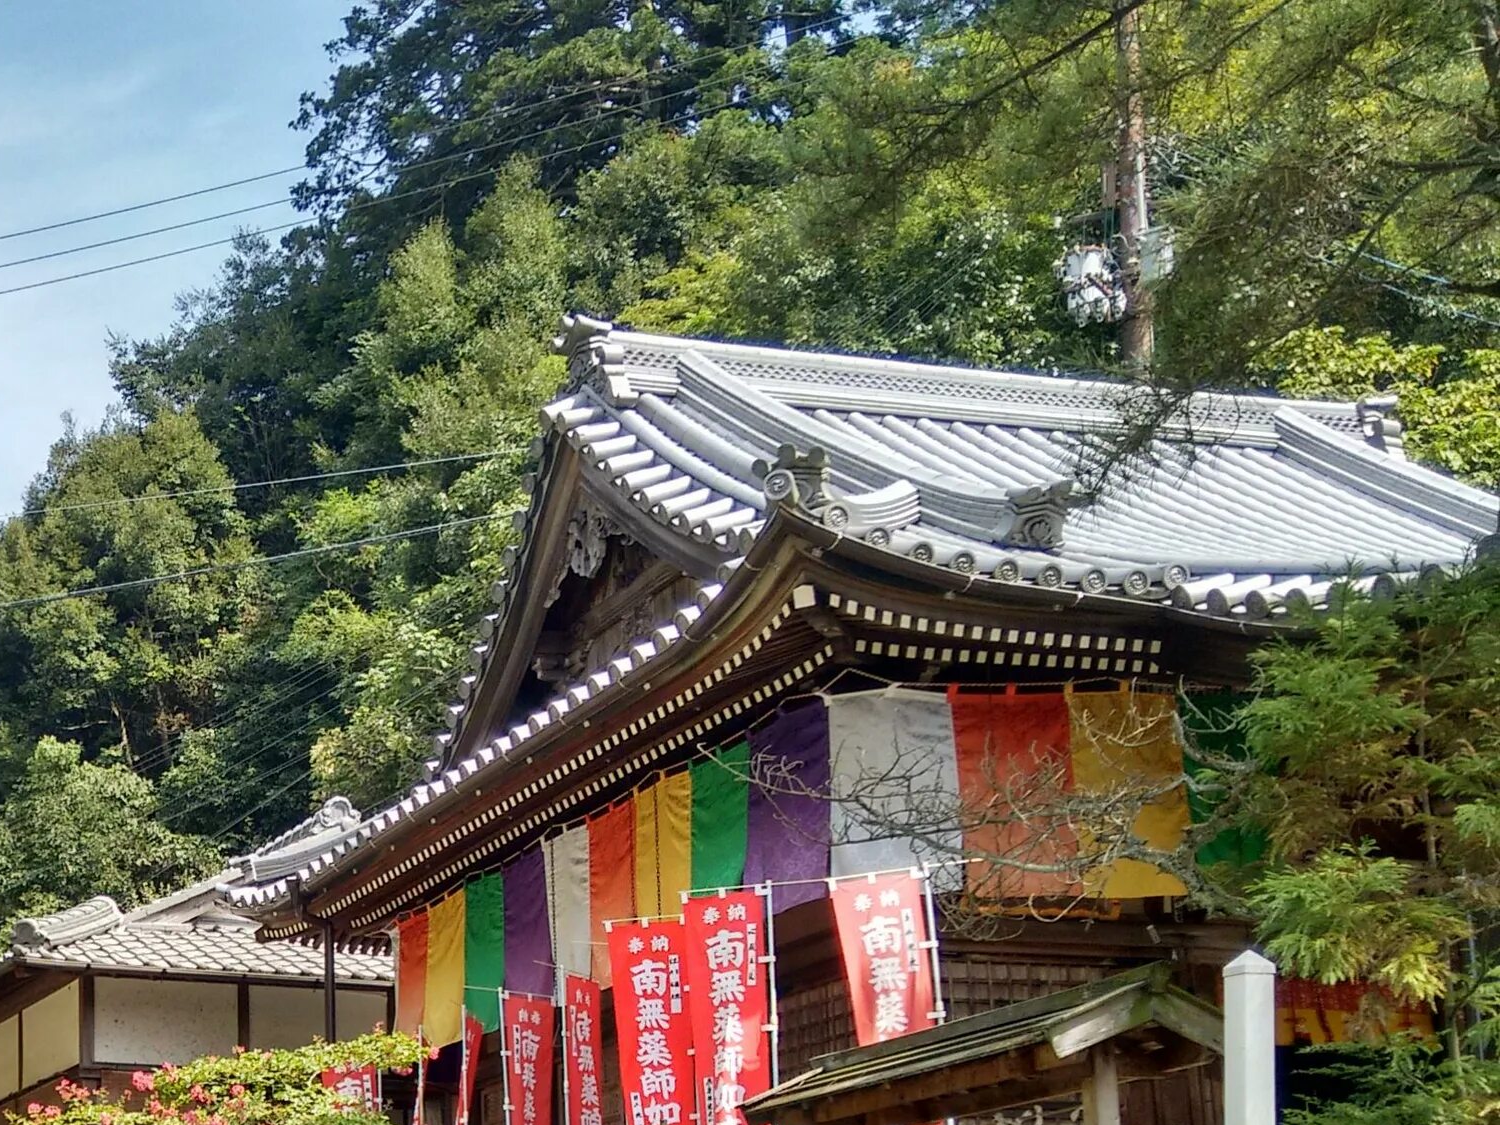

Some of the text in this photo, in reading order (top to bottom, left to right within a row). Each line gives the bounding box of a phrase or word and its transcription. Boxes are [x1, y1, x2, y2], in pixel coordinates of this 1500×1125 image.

[853, 888, 900, 912] 奉納
[702, 903, 747, 925] 奉納
[628, 935, 670, 953] 奉納
[859, 914, 909, 1042] 南無薬
